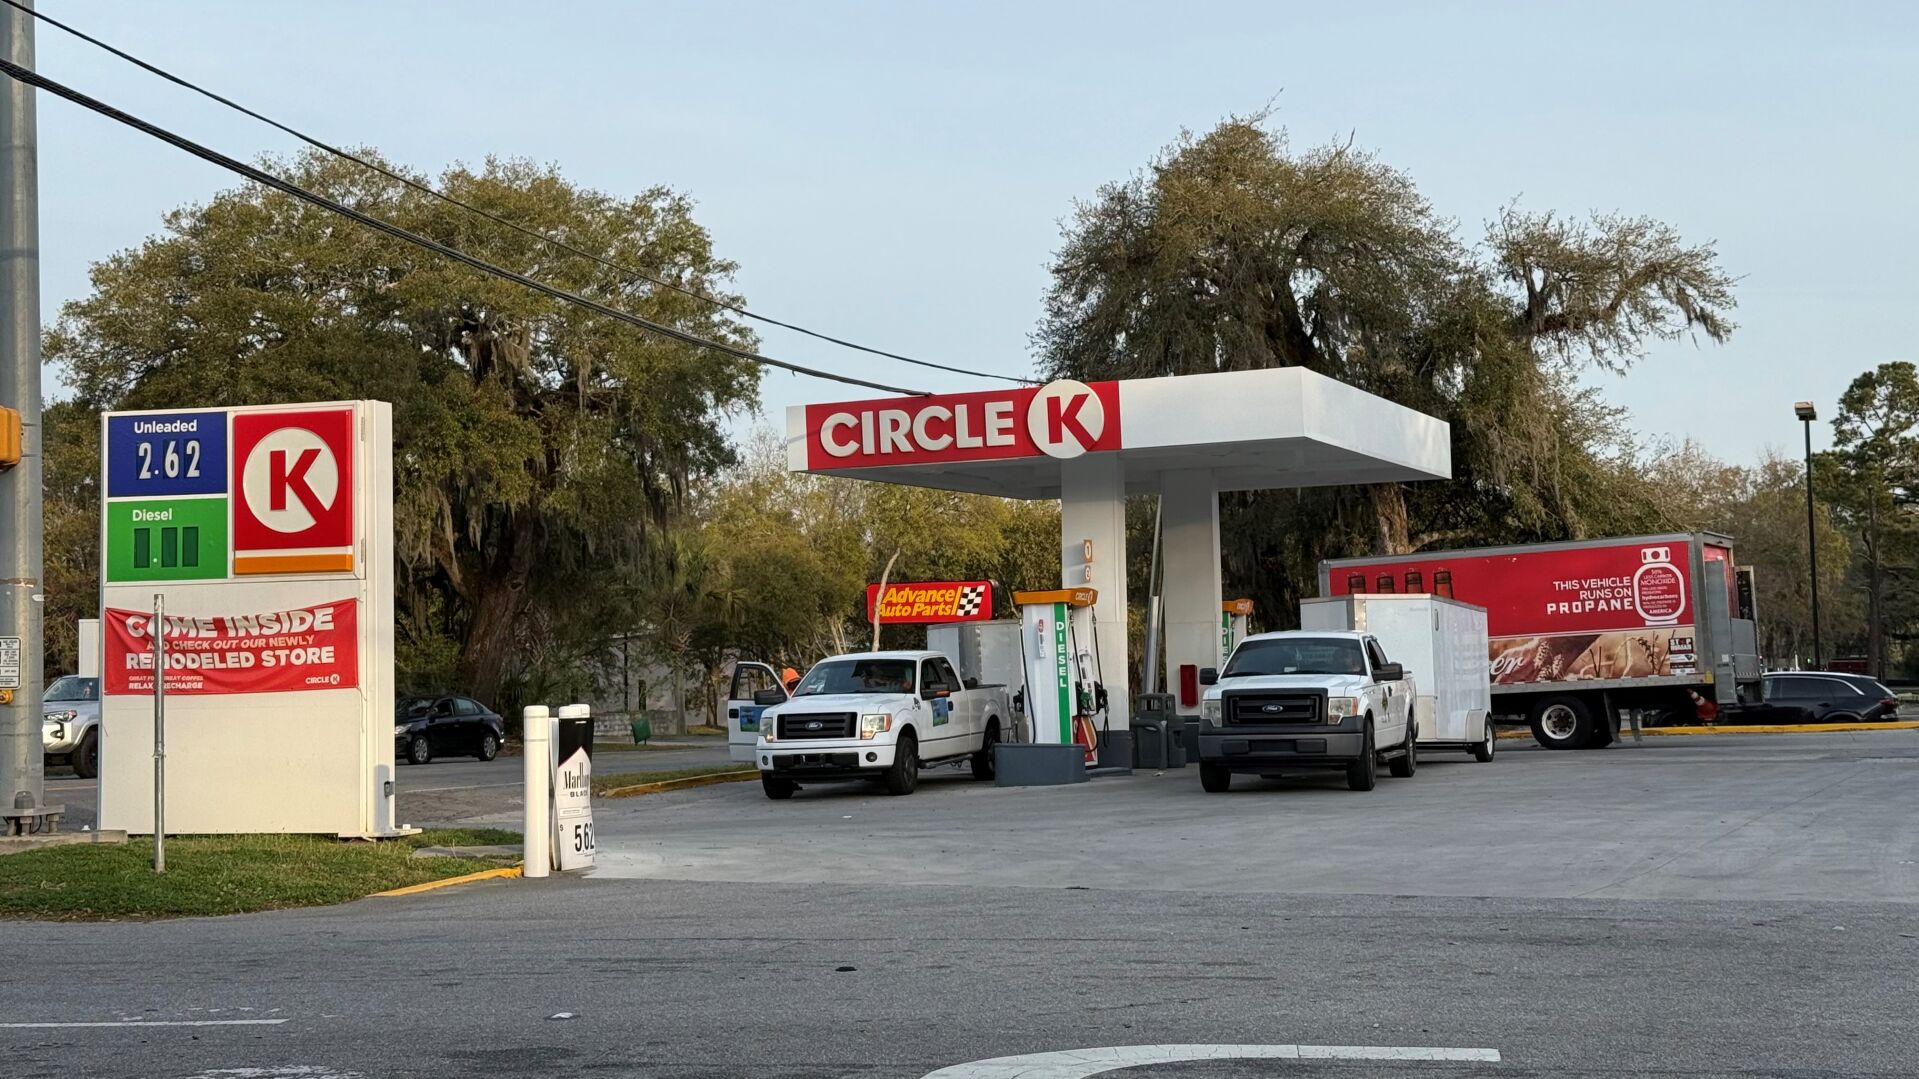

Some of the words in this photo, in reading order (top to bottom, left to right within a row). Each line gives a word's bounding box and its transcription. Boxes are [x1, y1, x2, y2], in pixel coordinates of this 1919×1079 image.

[134, 419, 197, 433] Unleaded
[820, 401, 1016, 458] CIRCLE
[1046, 393, 1098, 452] K
[138, 440, 200, 479] 2.62
[270, 448, 327, 521] K
[132, 508, 173, 521] Diesel
[1553, 580, 1580, 591] THIS
[1581, 576, 1631, 589] VEHICLE
[882, 587, 955, 604] Advance
[1580, 588, 1612, 600] RUNS
[1614, 587, 1632, 598] ON
[879, 604, 911, 617] Auto
[912, 602, 952, 616] Parts
[1547, 598, 1633, 615] PROPANE
[126, 615, 218, 638] COME
[224, 607, 334, 637] INSIDE
[147, 641, 170, 650] AD
[172, 641, 210, 650] CHECK
[213, 640, 240, 650] OUT
[241, 639, 266, 648] OUR
[269, 635, 314, 648] NEWLY
[261, 646, 334, 667] STORE
[1056, 622, 1067, 688] DIESEL
[305, 676, 330, 684] CIRCLE
